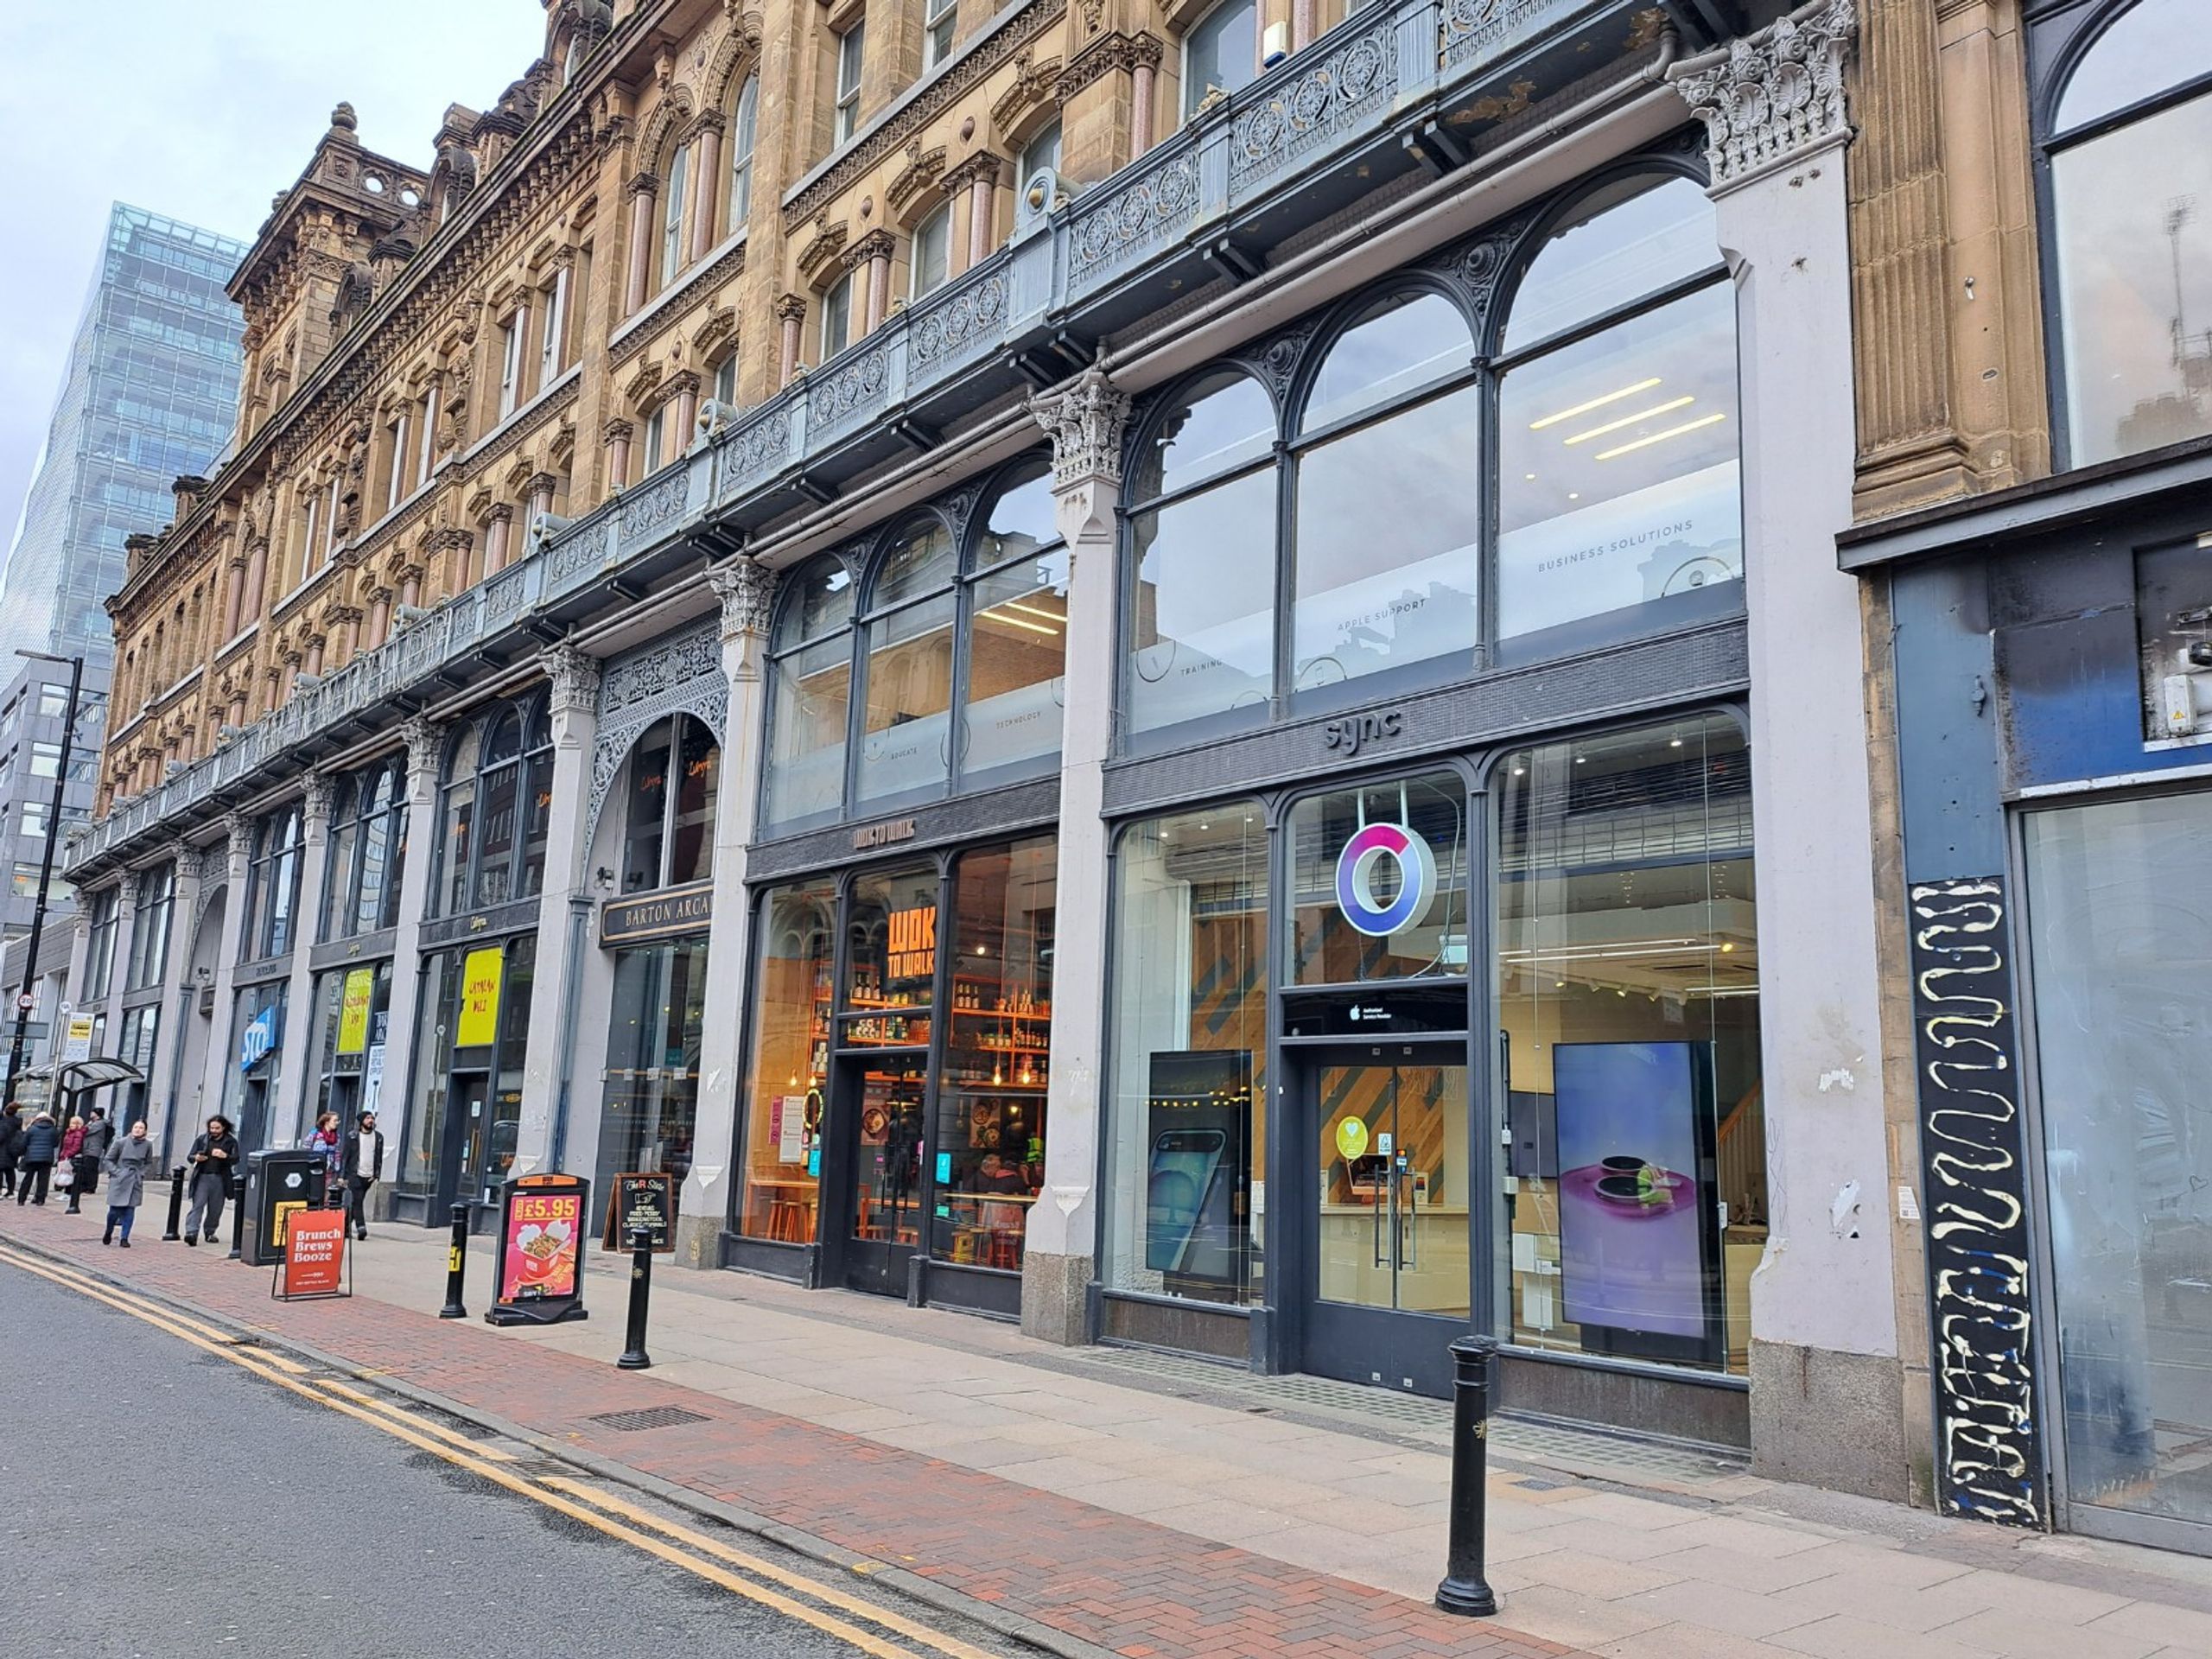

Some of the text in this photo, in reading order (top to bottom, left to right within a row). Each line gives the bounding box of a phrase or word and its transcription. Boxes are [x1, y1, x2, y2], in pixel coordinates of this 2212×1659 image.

[1538, 520, 1694, 573] BUSINESS SOLUTIONS
[1338, 598, 1426, 631] APPLE SUPPORT
[1179, 659, 1223, 677] TRAINING
[996, 711, 1041, 729] TECHNOLOGY
[1325, 709, 1402, 756] sync
[626, 897, 712, 926] BARTON ARCA
[888, 906, 936, 953] WOK
[887, 950, 934, 978] TO WALK
[524, 1198, 575, 1217] £5.95
[296, 1229, 340, 1241] Brunch
[296, 1242, 333, 1251] Brews
[294, 1253, 332, 1262] Booze
